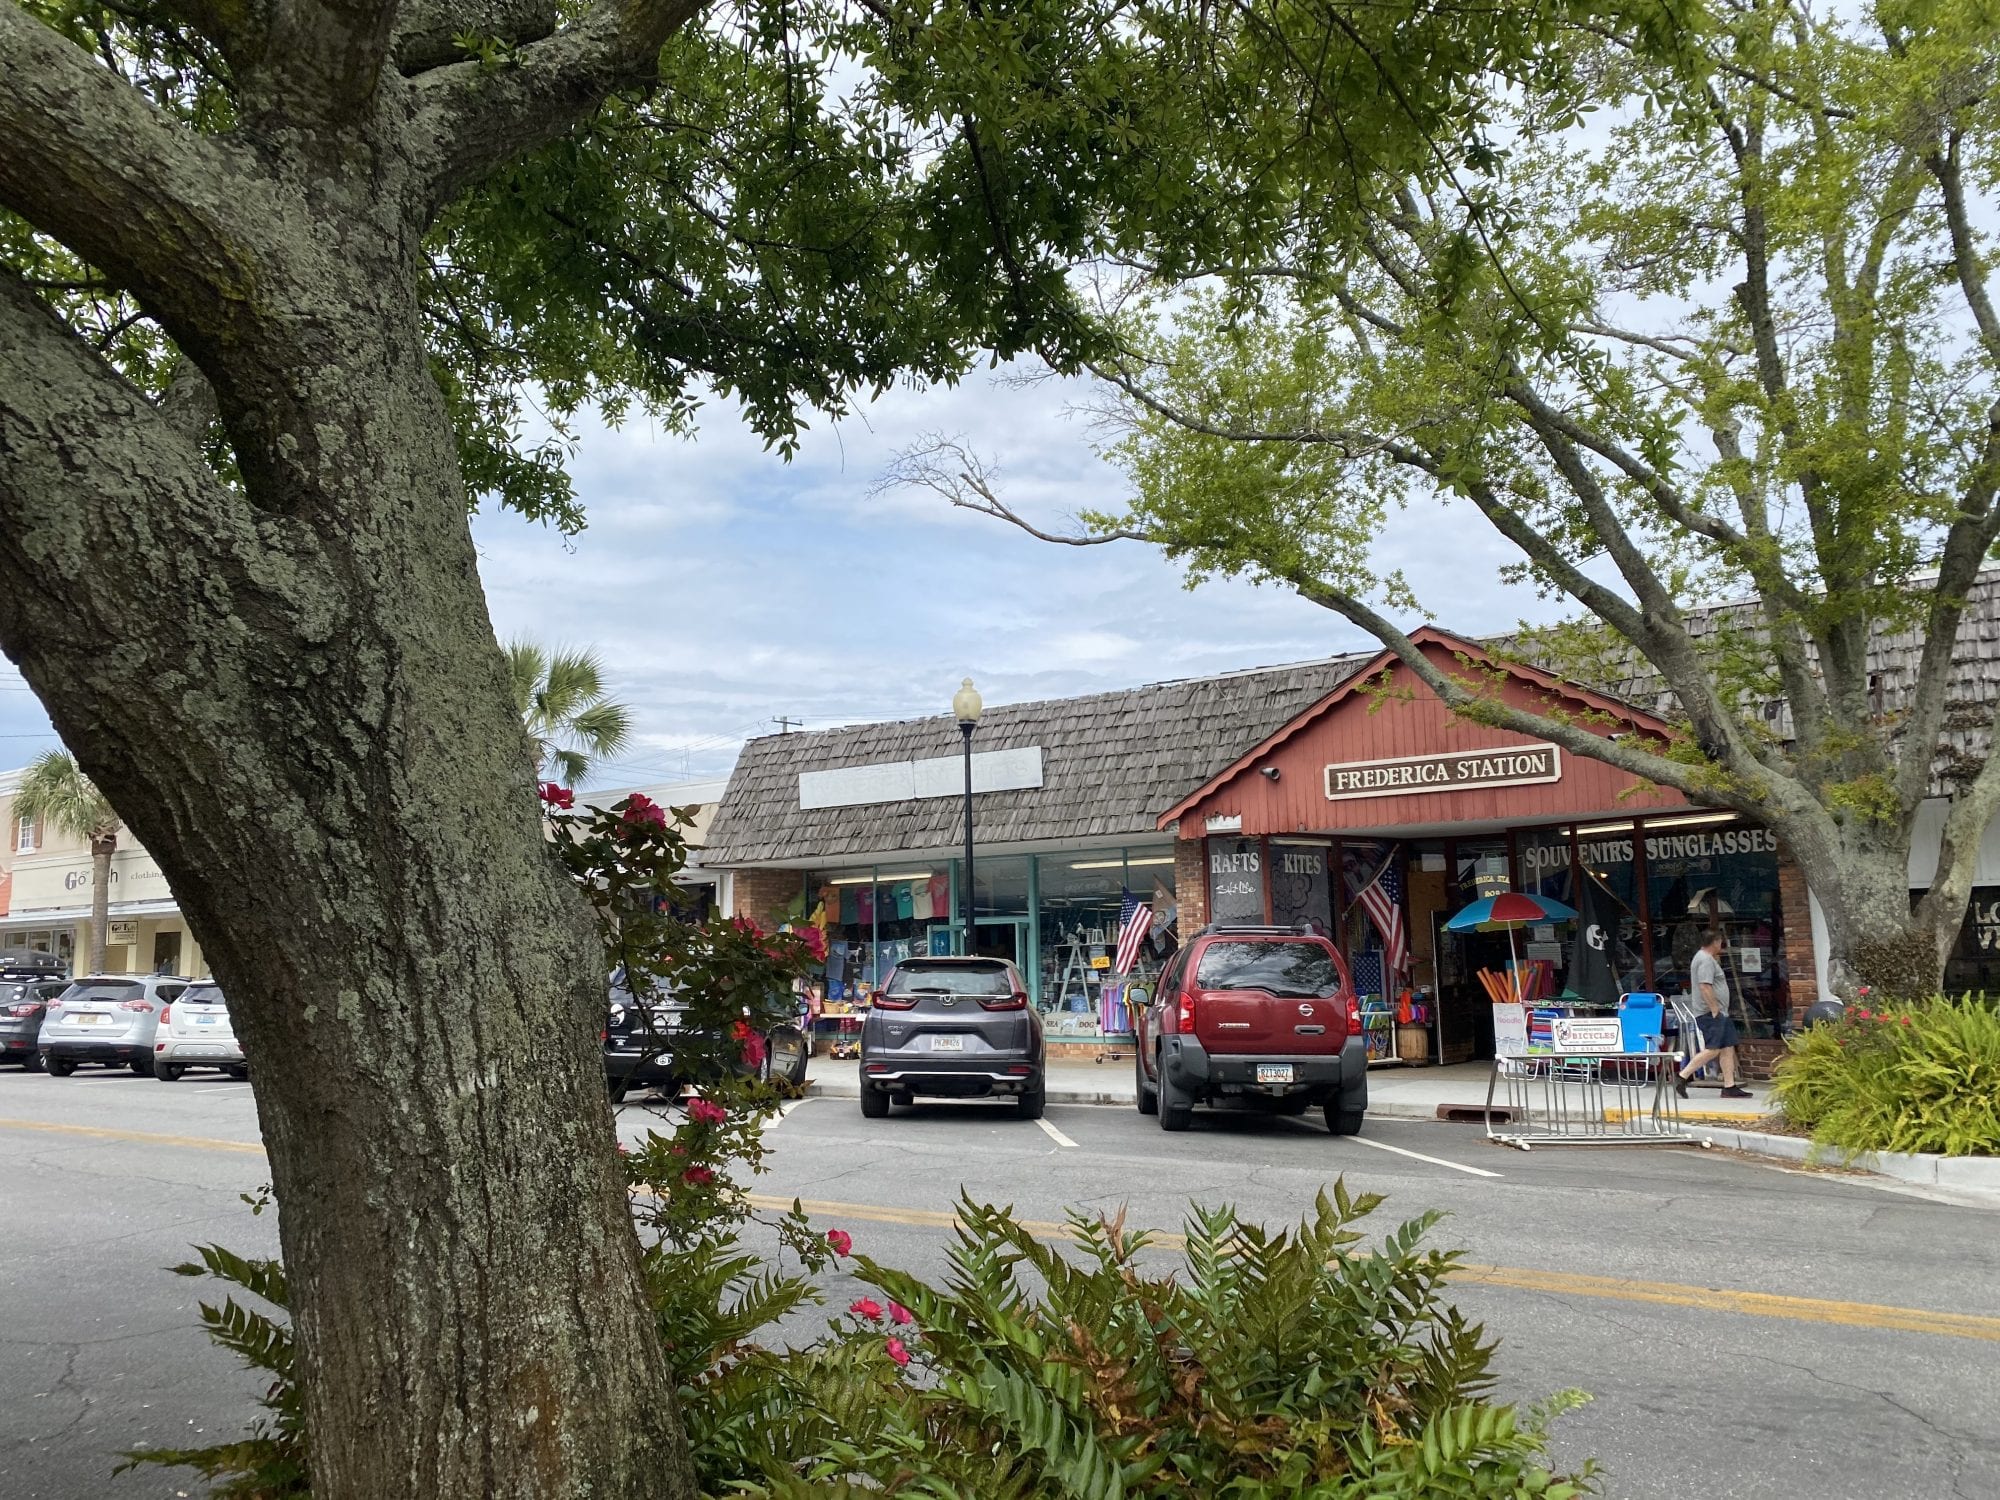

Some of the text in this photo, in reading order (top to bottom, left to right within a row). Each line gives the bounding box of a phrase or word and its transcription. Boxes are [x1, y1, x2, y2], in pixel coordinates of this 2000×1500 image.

[1336, 753, 1547, 790] FREDERICA STATION
[1526, 839, 1634, 868] SOUVENIRS
[1646, 829, 1777, 860] SUNGLASSES
[1211, 852, 1260, 874] RAFTS
[1284, 853, 1322, 874] KITES
[1046, 1020, 1095, 1029] SEA DOG
[1572, 1032, 1616, 1040] BICYCLES
